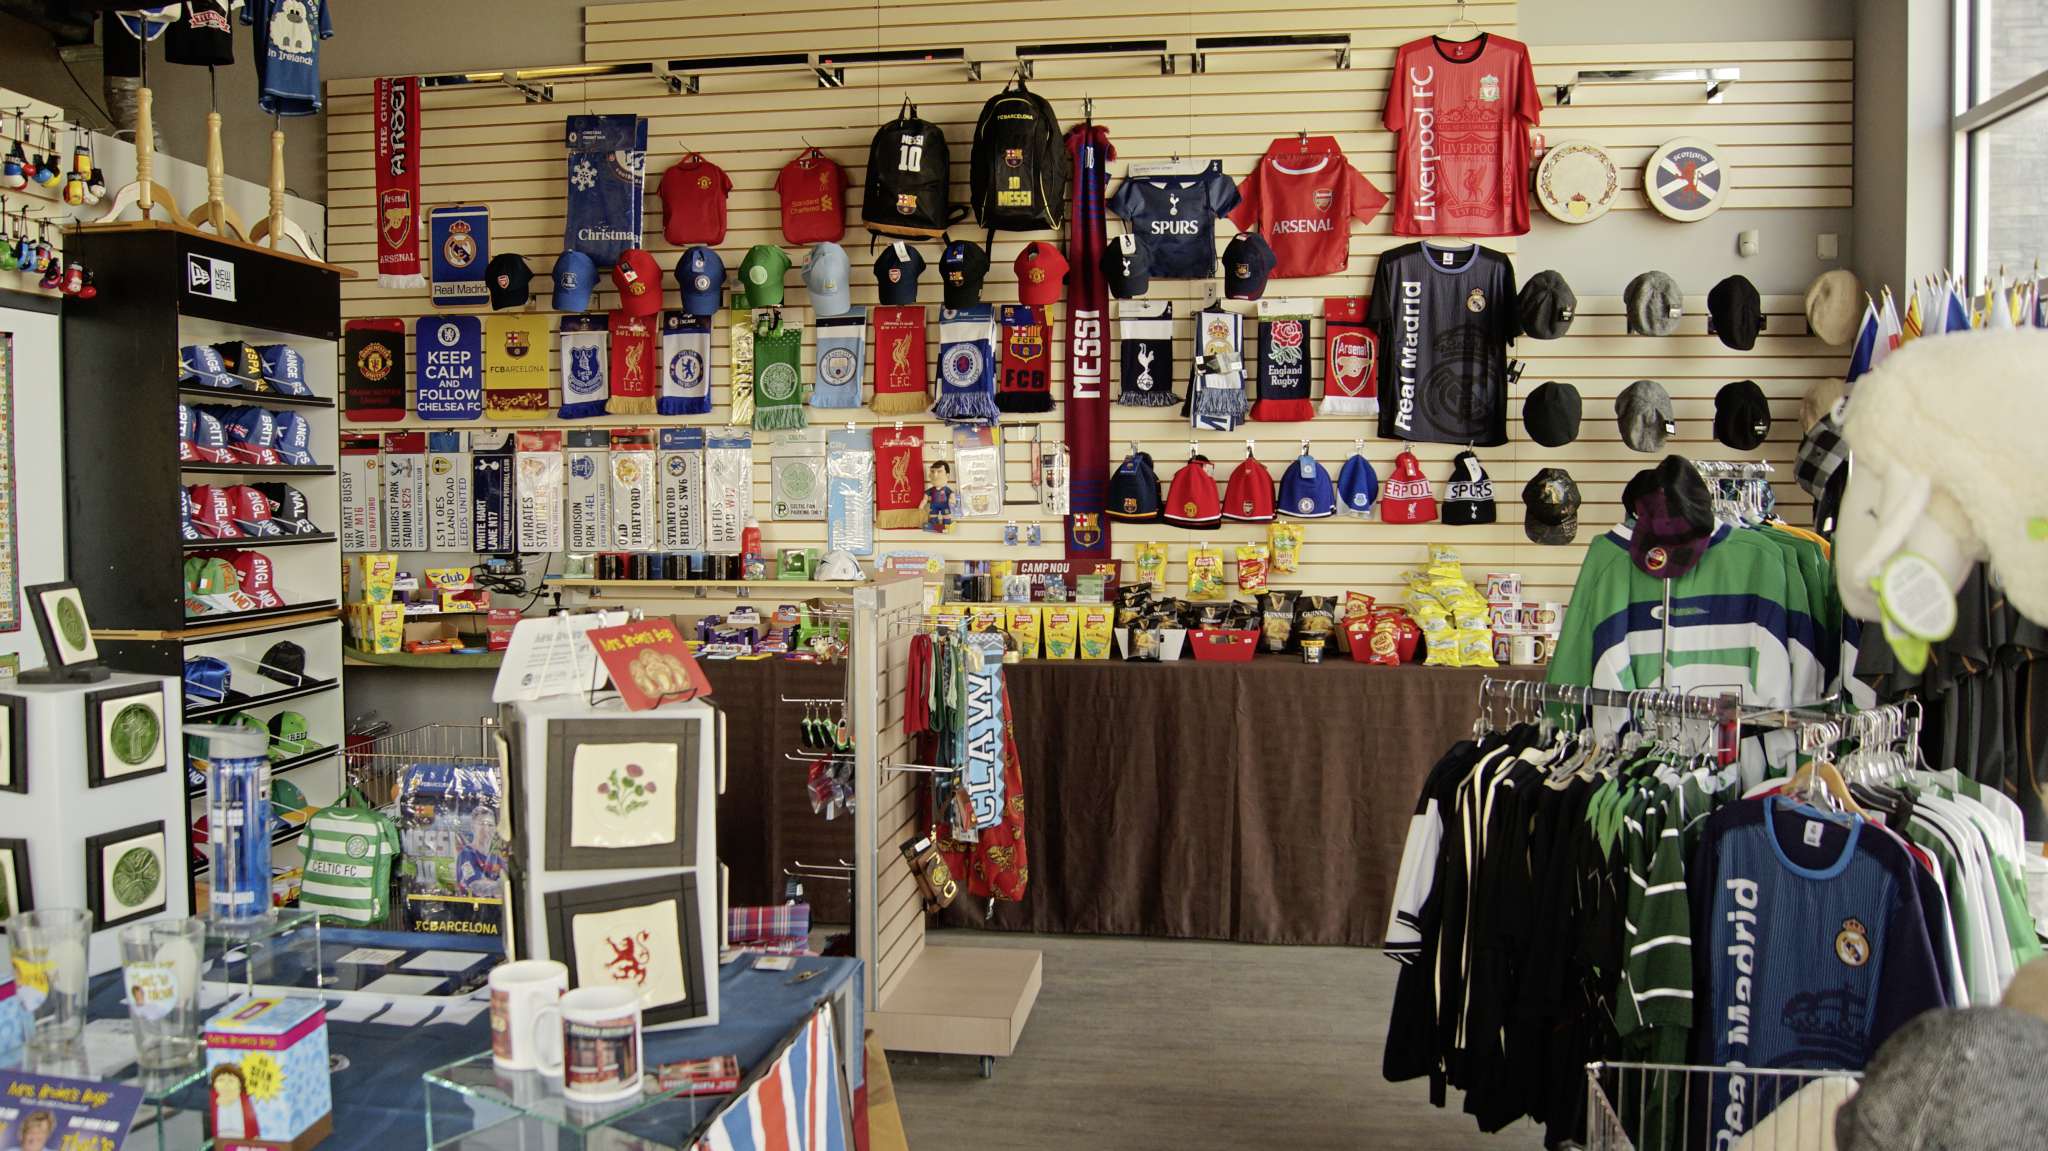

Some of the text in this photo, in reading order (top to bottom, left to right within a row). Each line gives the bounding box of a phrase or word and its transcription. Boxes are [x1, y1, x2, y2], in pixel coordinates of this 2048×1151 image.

[380, 125, 388, 156] THE
[902, 135, 924, 146] MESSI
[1411, 66, 1441, 221] Liverpool FC
[898, 146, 922, 173] 10
[1008, 176, 1021, 190] 10
[998, 191, 1032, 207] MESSI
[1151, 220, 1199, 235] SPURS
[1272, 219, 1334, 235] ARSENAL
[434, 283, 489, 295] Real Madrid
[428, 351, 471, 364] KEEP
[1073, 310, 1101, 399] MESSI
[1338, 341, 1369, 356] Arsenal
[1395, 281, 1422, 432] Real Madrid
[426, 366, 473, 379] CALM
[490, 365, 545, 373] FCBARCELONA
[1005, 369, 1045, 388] FCB
[1268, 365, 1303, 377] England
[439, 380, 460, 388] AND
[1271, 377, 1299, 388] Rugby
[417, 402, 464, 411] CHELSEA
[467, 402, 481, 411] FC
[420, 389, 480, 401] FOLLOW
[343, 472, 354, 548] SIR MATT BUSBY
[390, 481, 400, 548] SELHURST PARK
[402, 488, 412, 548] STADIUM SE25
[446, 477, 456, 548] ELLAND ROAD
[459, 477, 468, 547] LEEDS UNITED
[522, 497, 534, 547] EMIRATES
[585, 494, 596, 548] PARK L4 4EL
[631, 487, 641, 545] TRAFFORD
[666, 487, 677, 546] STAMFORD
[678, 479, 689, 545] BRIDGE SW6
[354, 507, 365, 548] WAY M16
[368, 497, 377, 548] OLD TRAFFORD
[476, 499, 487, 551] WHITE HART
[487, 511, 498, 550] LANE N17
[536, 501, 548, 548] STADIUM
[573, 502, 583, 548] GOODISON
[618, 523, 628, 545] OLD
[725, 513, 736, 542] ROAD
[440, 571, 465, 584] club
[1021, 563, 1070, 573] CAMP NOU
[456, 602, 473, 610] club
[1264, 611, 1293, 619] GUINNESS
[1302, 610, 1333, 618] GUINNESS
[401, 831, 456, 857] MESSI
[312, 860, 357, 877] CELTIC FC
[415, 920, 498, 934] FCBARCELONA
[1726, 878, 1760, 1046] Madrid
